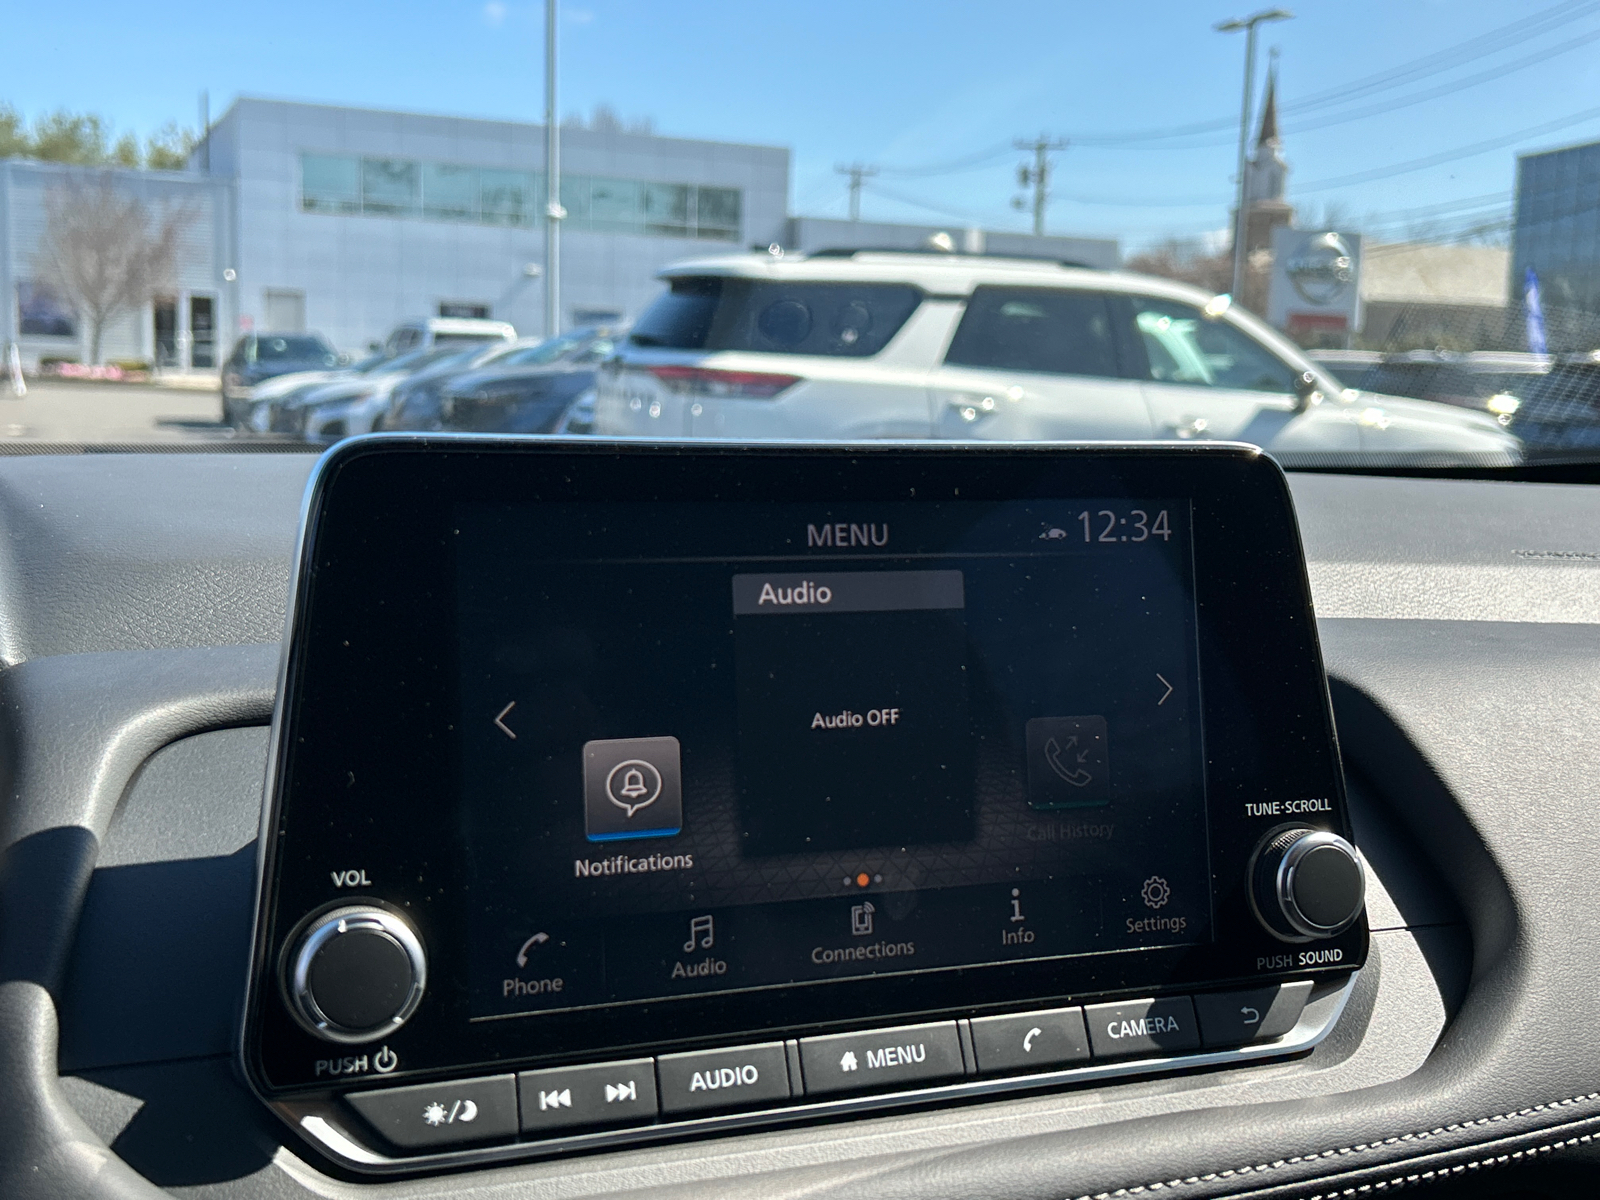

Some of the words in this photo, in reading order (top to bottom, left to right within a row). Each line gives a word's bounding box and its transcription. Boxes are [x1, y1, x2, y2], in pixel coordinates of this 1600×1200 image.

[806, 523, 890, 548] MENU
[1077, 509, 1172, 543] 12:34
[757, 580, 832, 605] Audio
[811, 711, 864, 729] Audio
[867, 708, 900, 726] OFF
[1026, 825, 1056, 843] Call
[1060, 822, 1115, 841] History
[574, 853, 694, 878] Notifications
[331, 869, 372, 888] VOL
[1126, 916, 1188, 934] Settings
[1001, 928, 1036, 946] Info
[811, 940, 916, 965] Connections
[1256, 956, 1294, 970] PUSH
[1298, 949, 1344, 967] SOUND
[670, 957, 728, 980] Audio
[502, 976, 564, 997] Phone
[1107, 1015, 1180, 1040] CAMERA
[315, 1054, 368, 1076] PUSH
[866, 1043, 927, 1070] MENU
[689, 1064, 760, 1093] AUDIO
